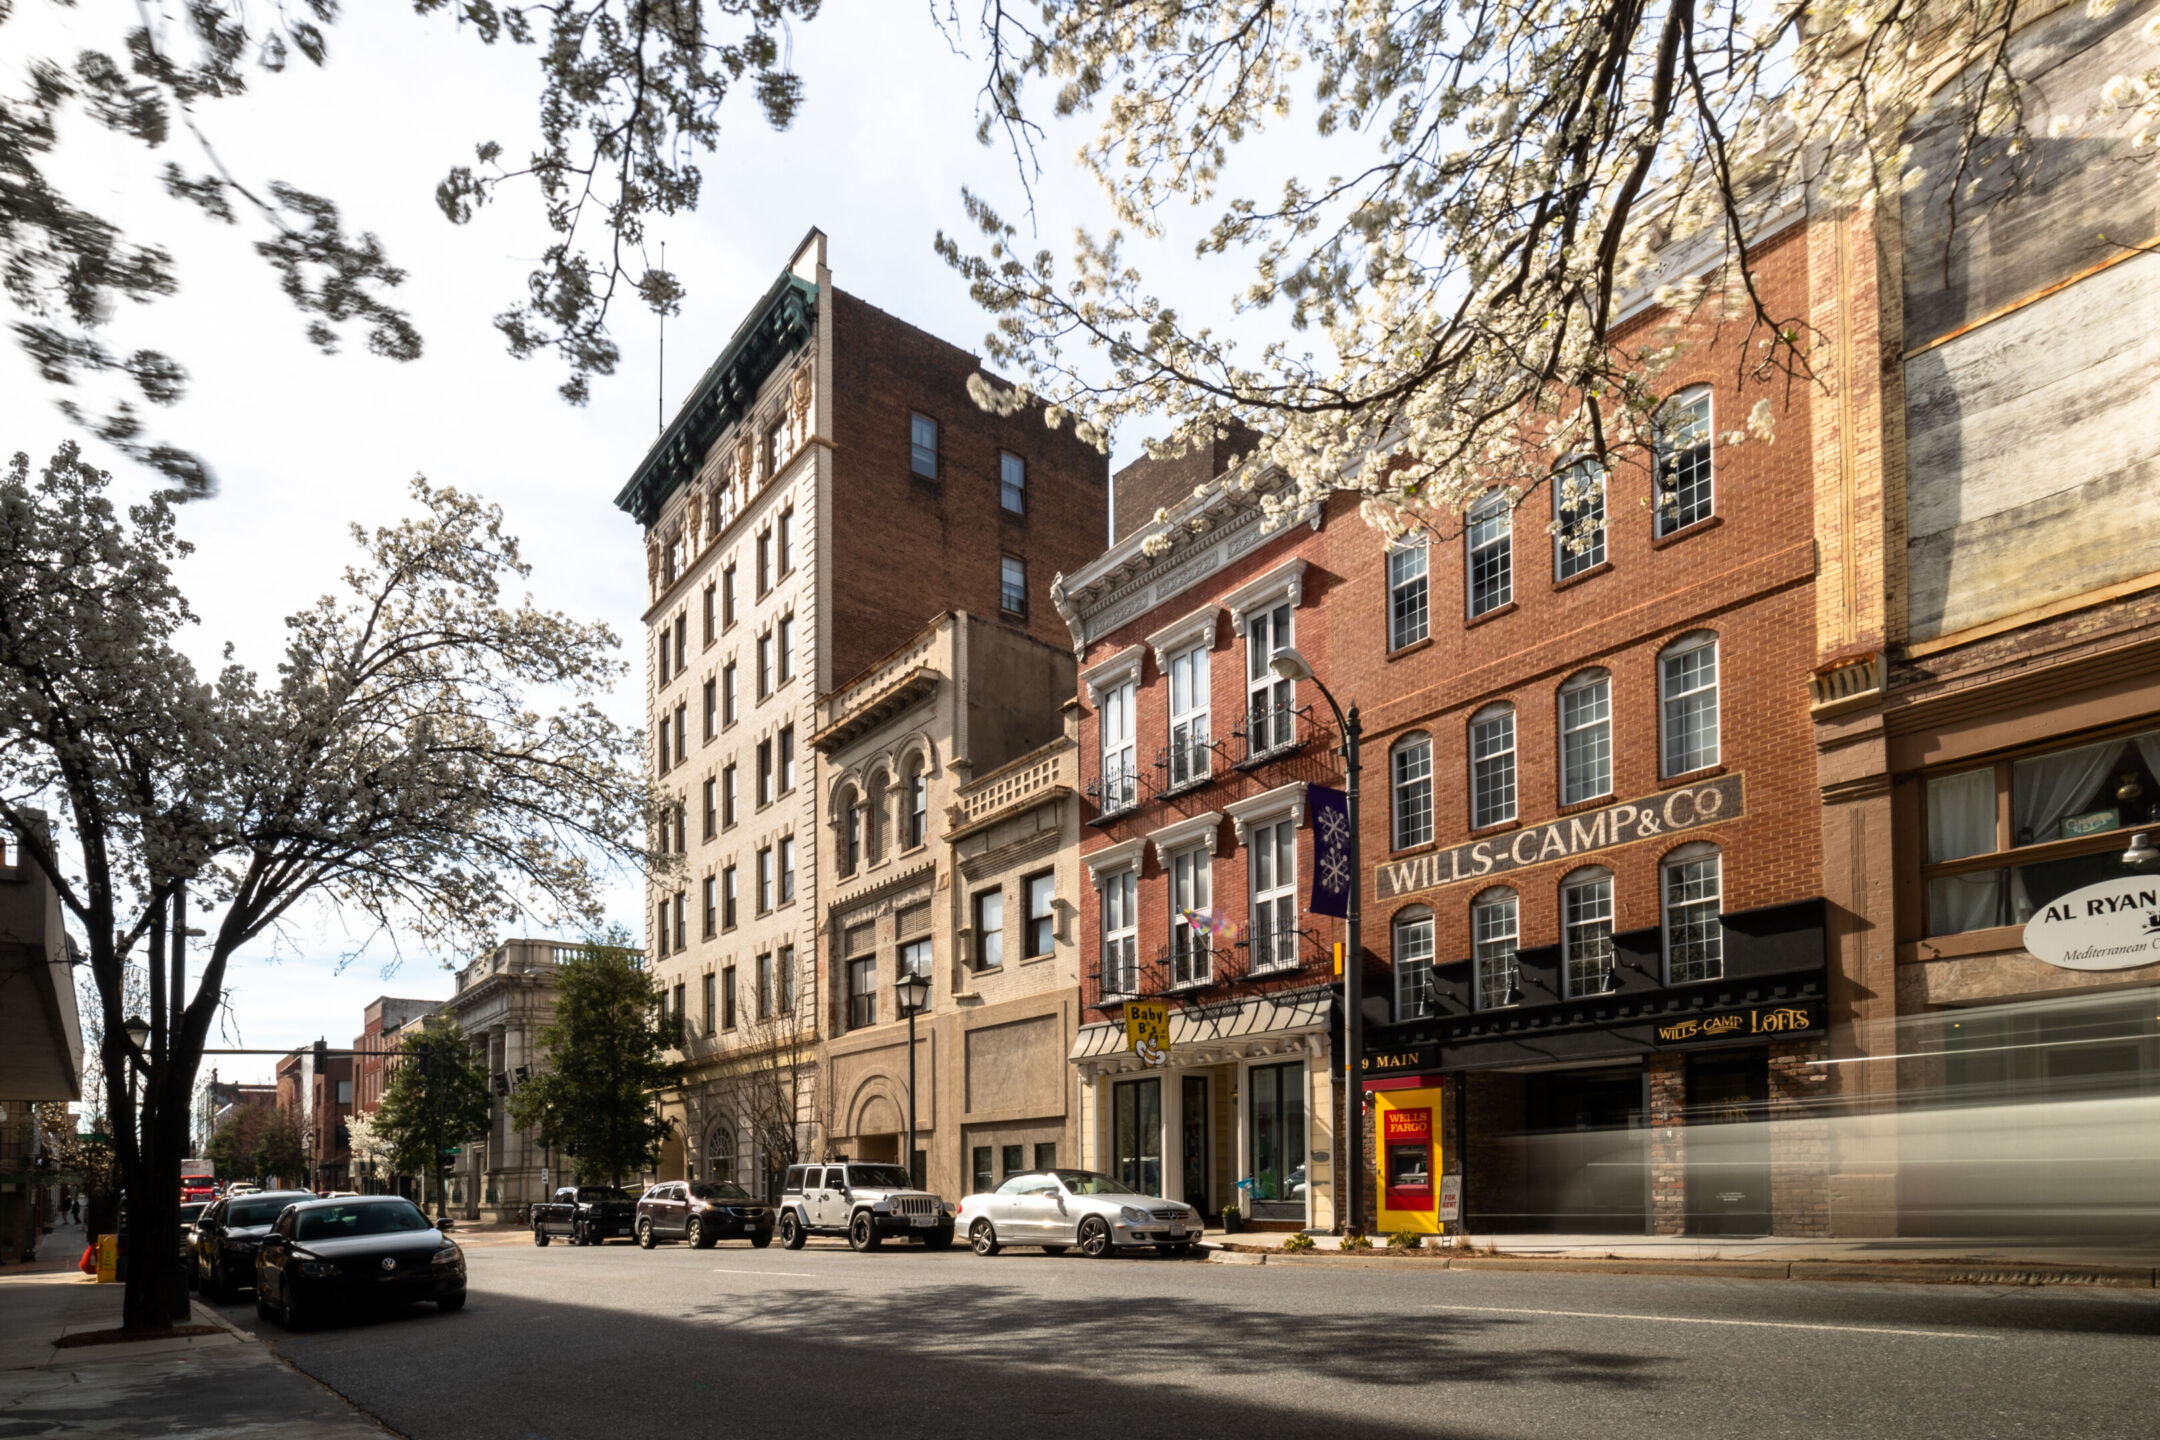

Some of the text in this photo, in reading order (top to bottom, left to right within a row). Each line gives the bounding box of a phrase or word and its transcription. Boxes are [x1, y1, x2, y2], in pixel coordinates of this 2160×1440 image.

[2044, 889, 2158, 924] AL RYAN
[2063, 942, 2147, 962] Mediterranean
[1131, 1006, 1163, 1024] Baby
[1658, 1007, 1810, 1041] WILLS-CAMP LOFTS
[1376, 1052, 1420, 1069] MAIN
[1388, 1112, 1428, 1123] WELLS
[1390, 1122, 1428, 1133] FARGO
[1442, 1201, 1457, 1209] RENT
[1444, 1193, 1457, 1201] FOR
